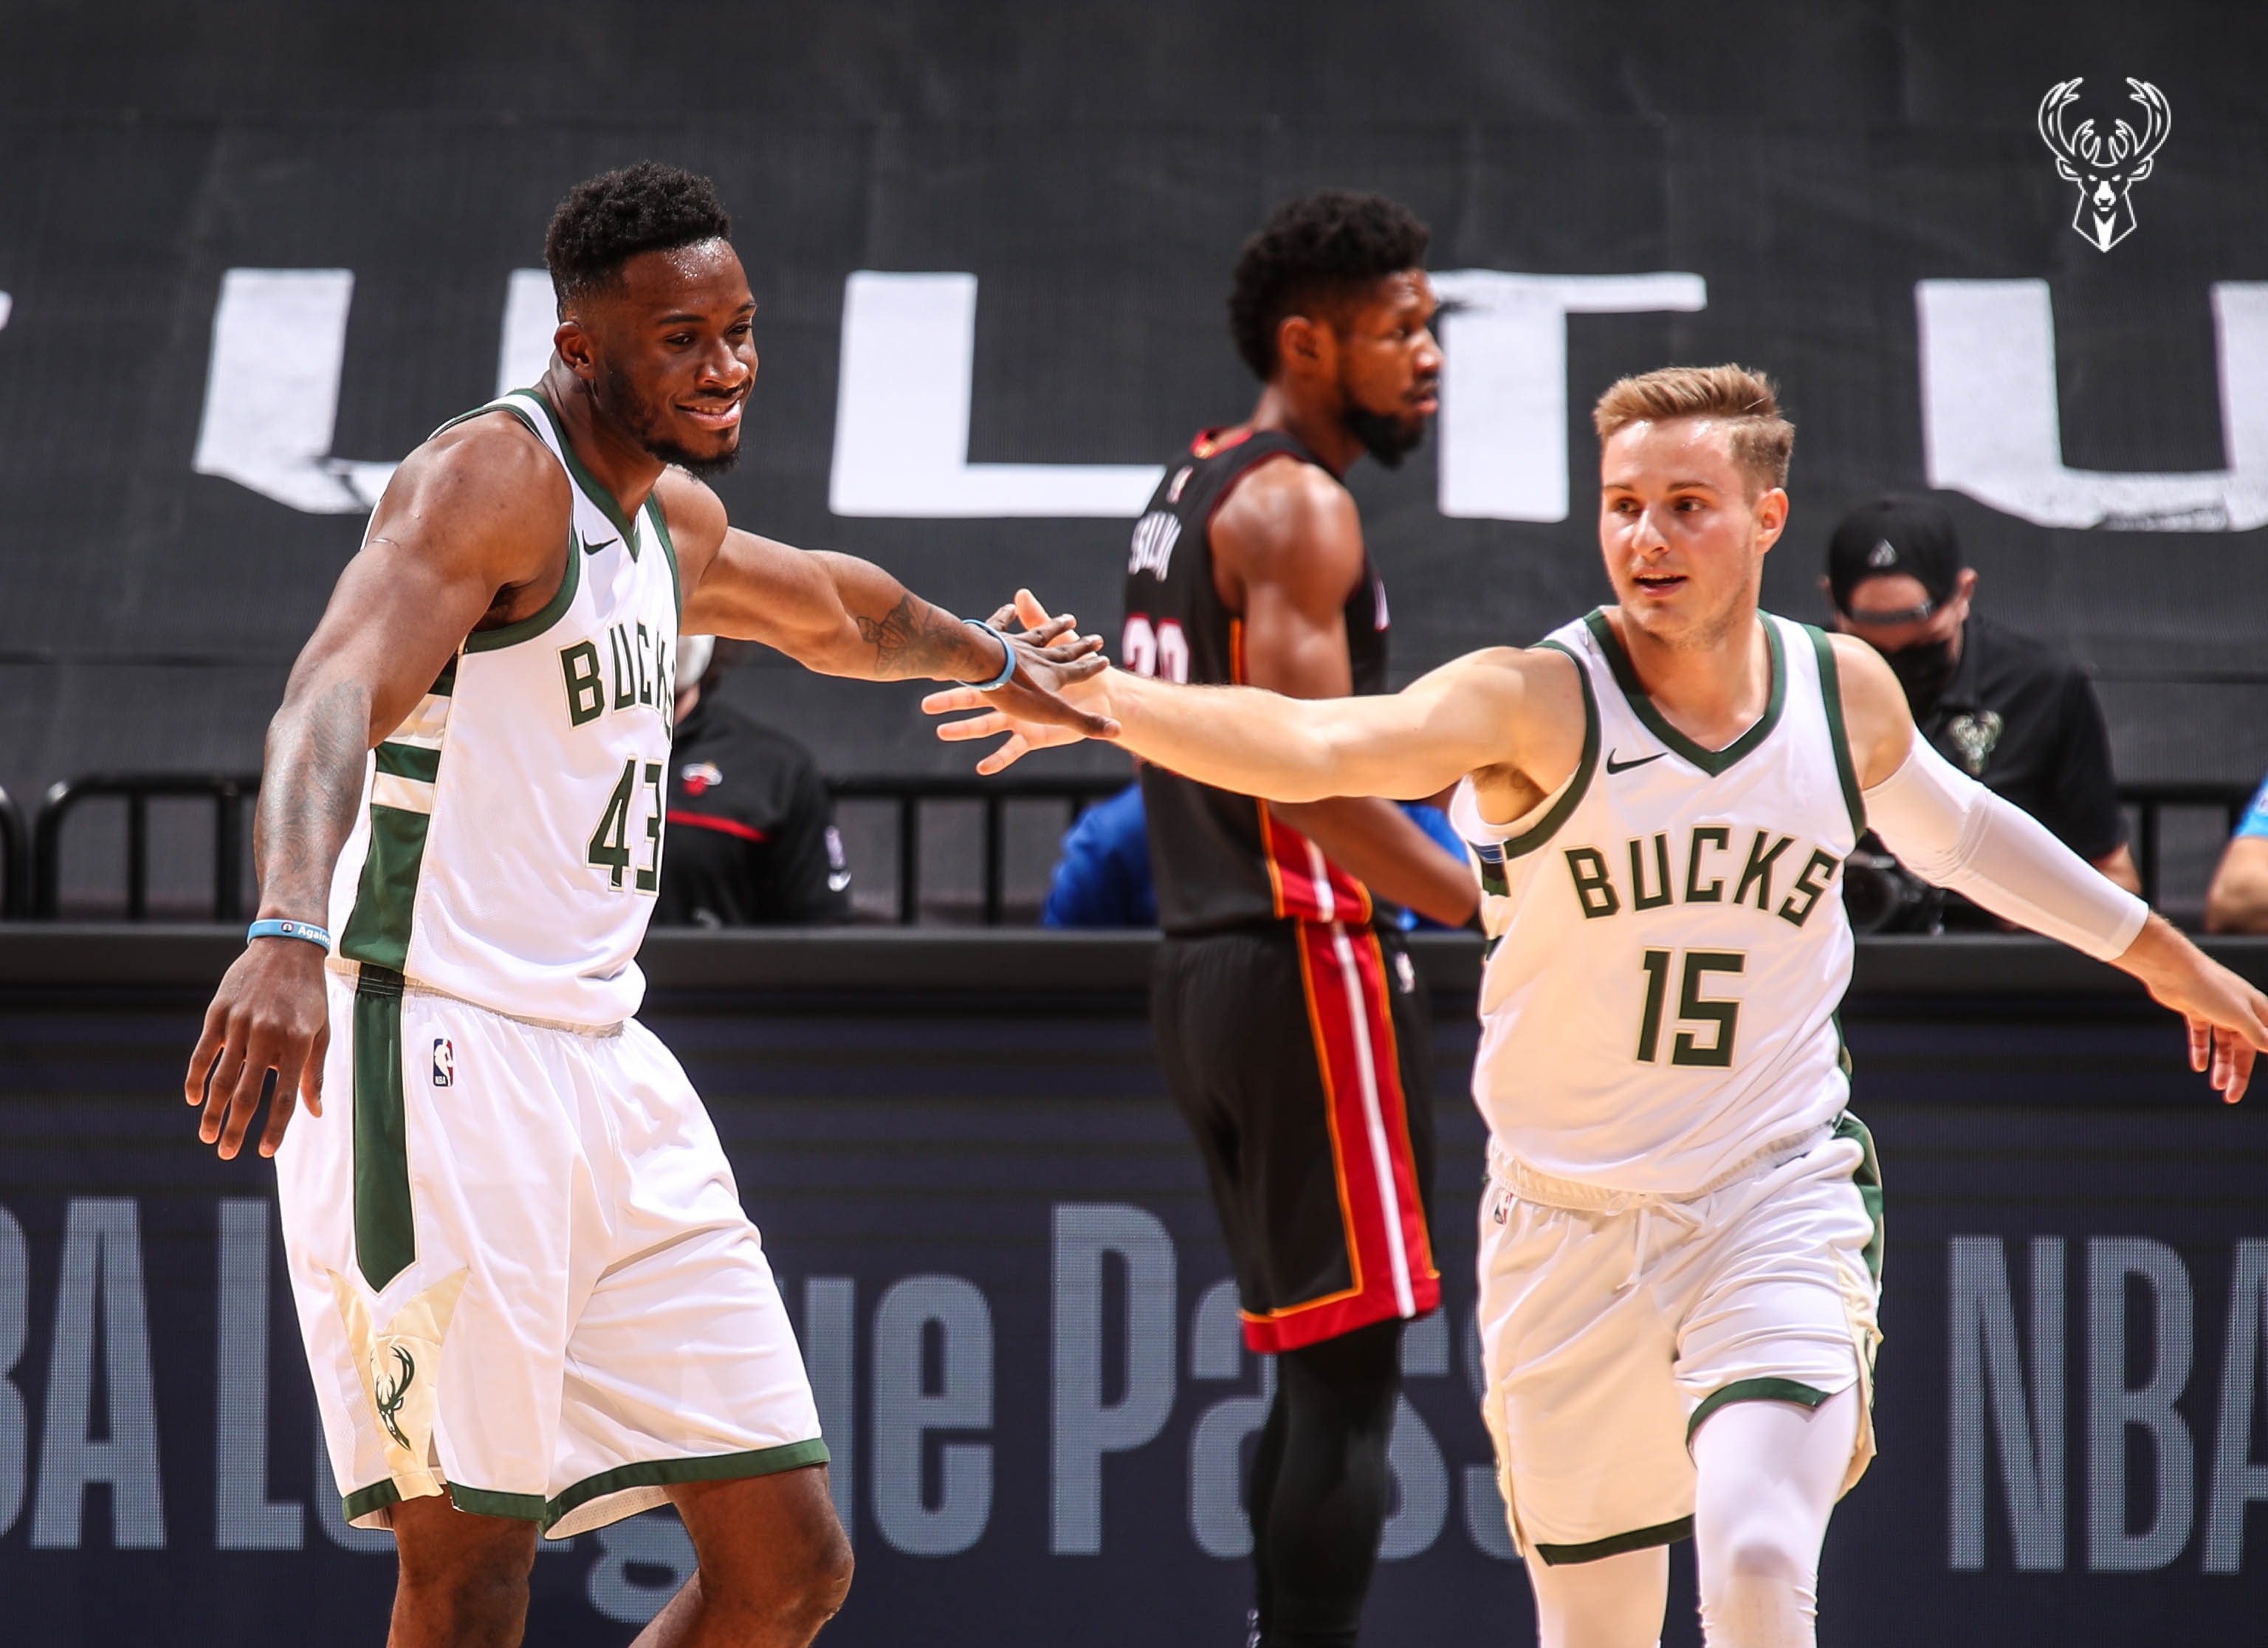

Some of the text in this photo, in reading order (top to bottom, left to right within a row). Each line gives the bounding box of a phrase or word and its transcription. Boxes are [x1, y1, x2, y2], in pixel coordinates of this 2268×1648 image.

[0, 267, 2268, 533] ULTU
[585, 753, 664, 896] 43
[1561, 824, 1843, 928] BUCKS
[1634, 947, 1749, 1069] 15
[0, 1197, 167, 1551] A
